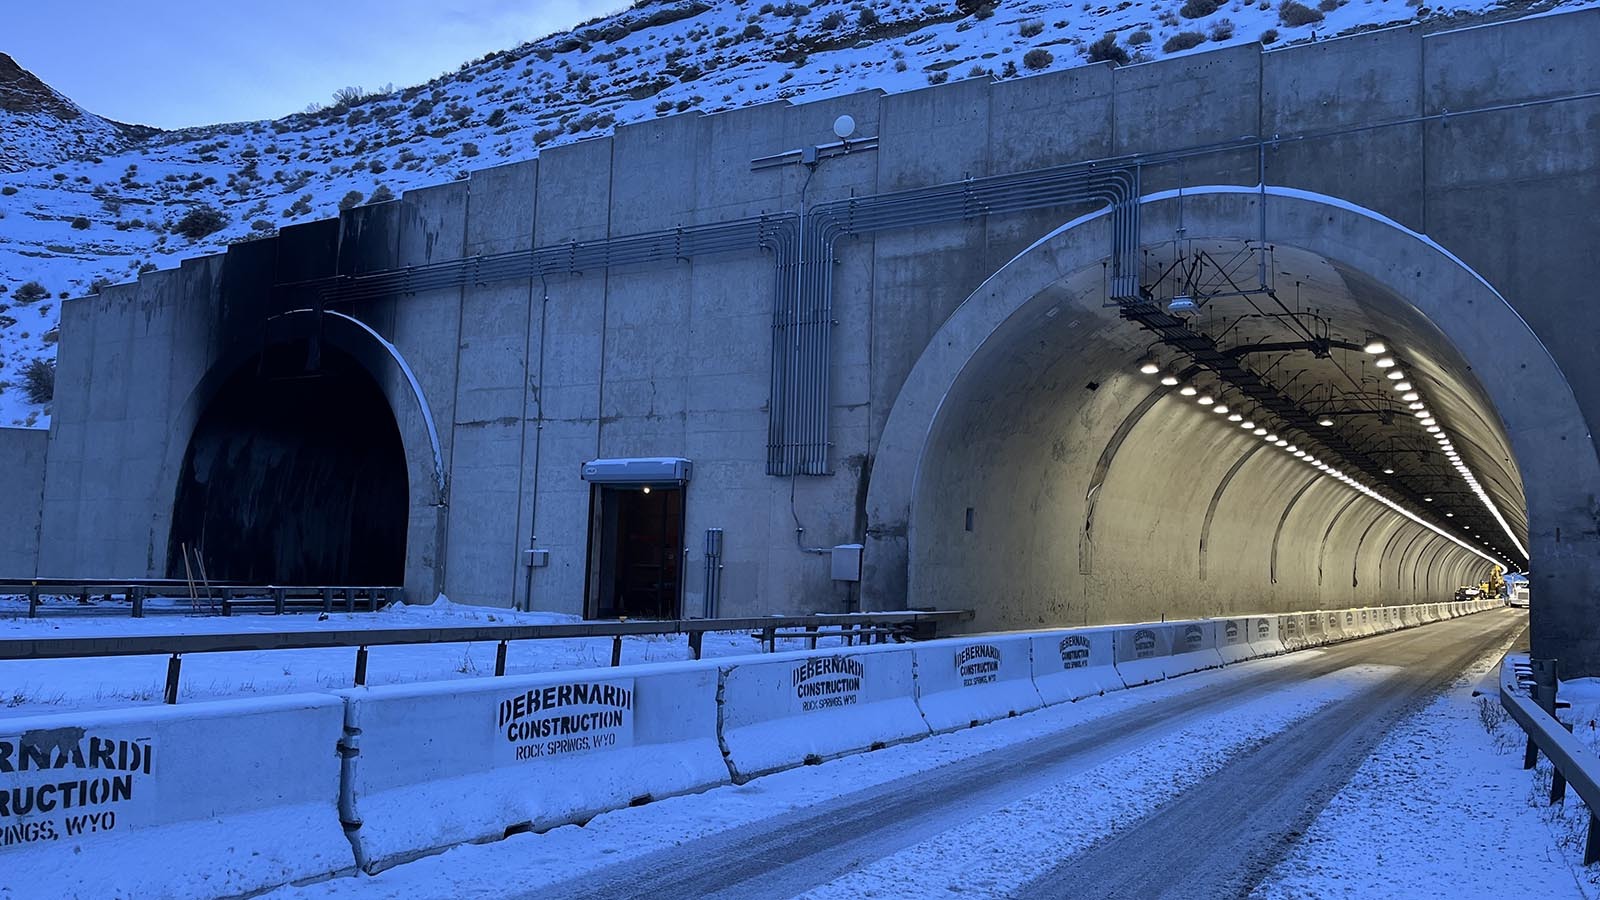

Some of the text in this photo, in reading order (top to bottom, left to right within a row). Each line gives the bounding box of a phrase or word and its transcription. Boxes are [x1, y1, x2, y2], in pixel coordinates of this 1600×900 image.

[793, 658, 864, 688] DEBERNARDI
[798, 678, 860, 699] CONSTRUCTION
[499, 684, 631, 729] DEBERNARDI
[507, 710, 623, 742] CONSTRUCTION
[516, 733, 616, 761] ROCK SPRINGS, WYO
[65, 811, 115, 836] WYO
